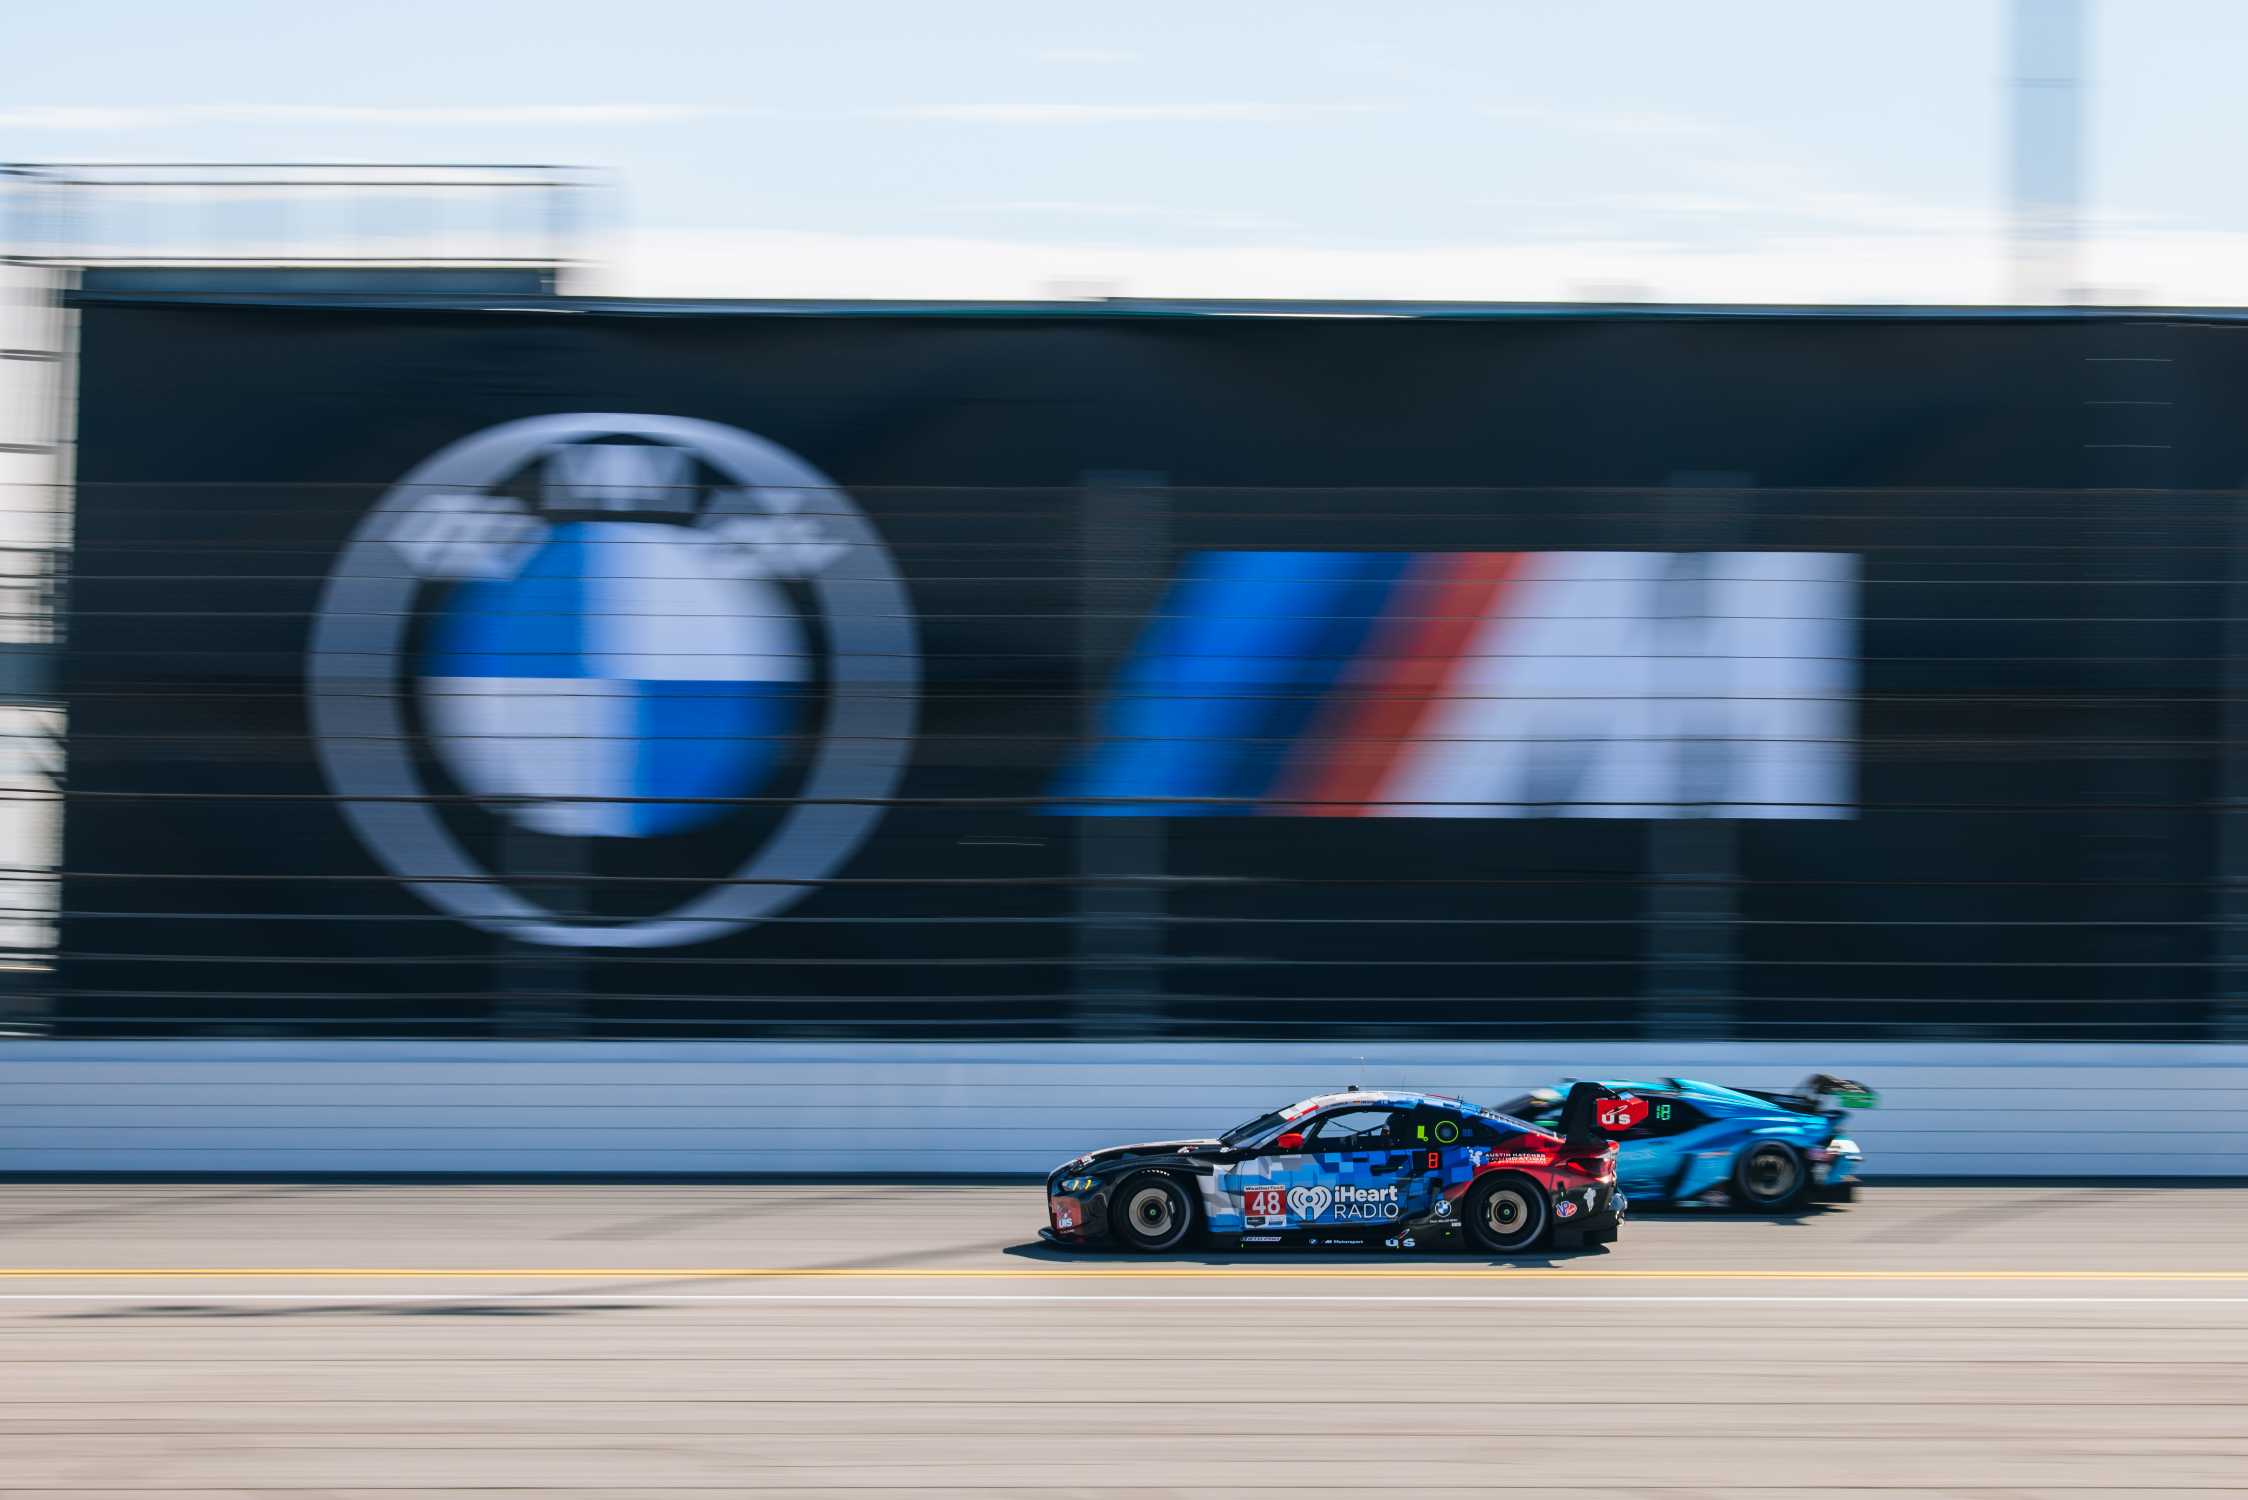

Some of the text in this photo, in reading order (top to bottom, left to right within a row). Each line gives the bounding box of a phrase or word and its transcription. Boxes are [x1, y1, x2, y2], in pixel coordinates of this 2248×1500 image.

[1428, 1152, 1439, 1169] 8
[1334, 1186, 1398, 1202] iHeart
[1252, 1191, 1280, 1215] 48
[1334, 1203, 1399, 1219] RADIO
